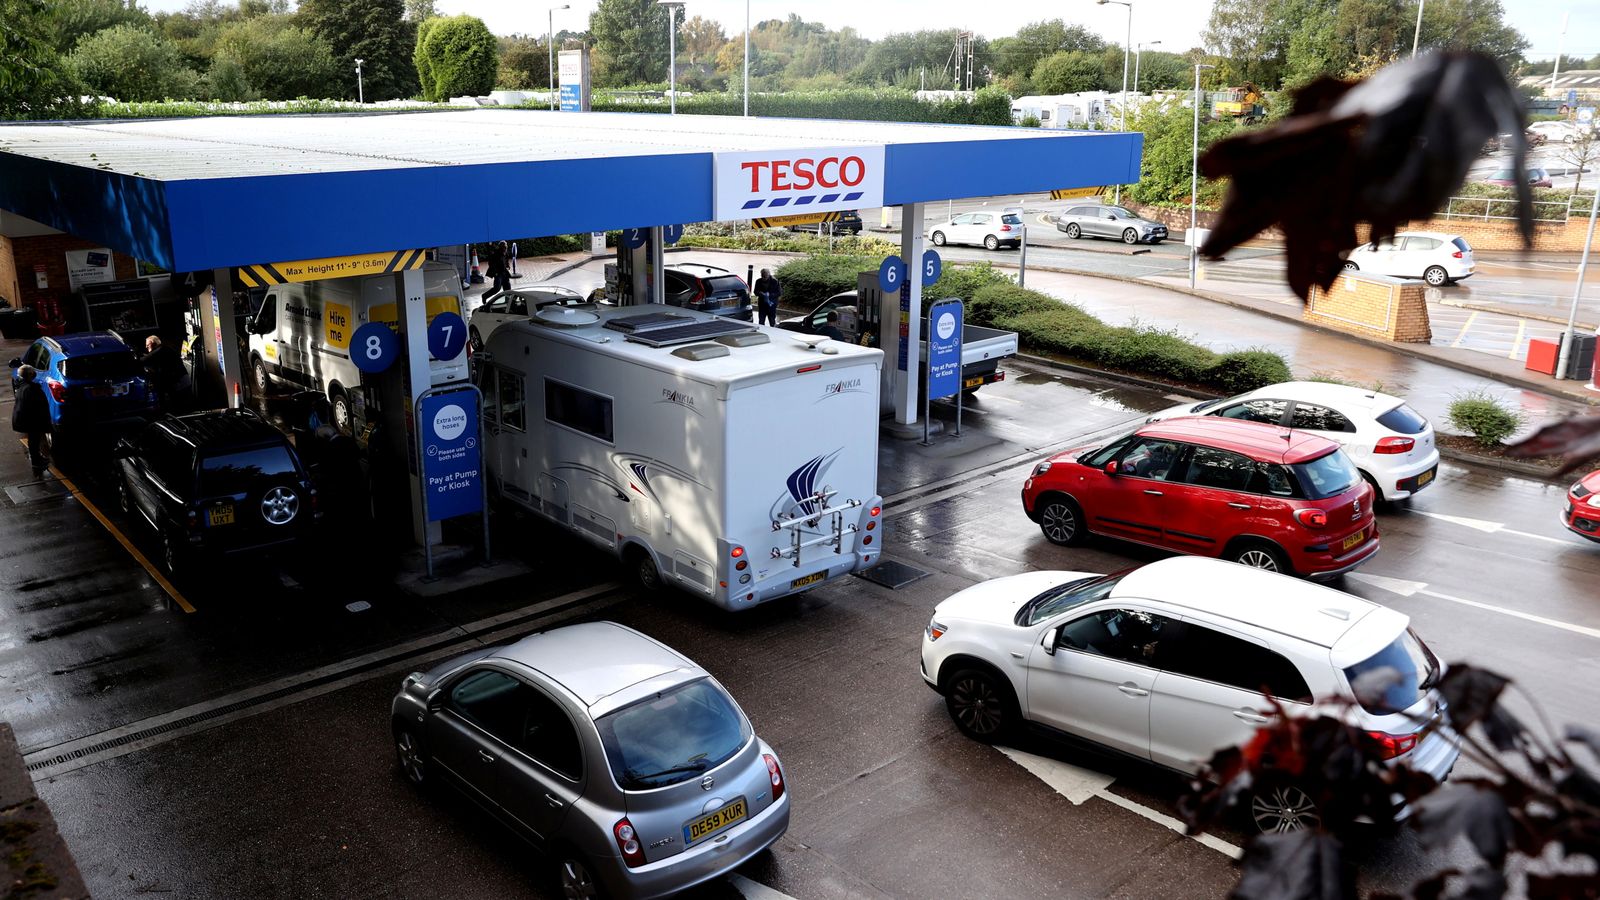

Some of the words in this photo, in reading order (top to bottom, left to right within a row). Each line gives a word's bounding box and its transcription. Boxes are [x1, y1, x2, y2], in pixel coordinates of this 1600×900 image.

[741, 156, 865, 192] TESCO
[631, 228, 639, 241] 2
[668, 225, 674, 237] 1
[285, 267, 303, 276] Max
[307, 264, 334, 275] Height
[362, 258, 387, 270] (3.6m)
[887, 266, 896, 283] 6
[926, 260, 934, 277] 5
[184, 272, 197, 287] 4
[285, 302, 304, 316] Arnold
[305, 307, 322, 321] Clark
[329, 310, 346, 327] Hire
[330, 329, 342, 342] me
[441, 326, 453, 348] 7
[366, 335, 382, 360] 8
[941, 369, 953, 377] Kiosk
[825, 378, 861, 393] FRANKIA
[662, 388, 694, 406] FRANKIA
[436, 415, 451, 425] Extra
[452, 414, 465, 423] long
[442, 422, 460, 431] hoses
[438, 448, 455, 456] Please
[429, 476, 443, 486] Pay
[445, 474, 453, 482] at
[454, 469, 478, 480] Pump
[438, 485, 447, 493] or
[448, 479, 470, 490] Kiosk
[213, 514, 230, 524] UXT
[691, 814, 720, 838] DE59
[723, 803, 743, 823] XUR
